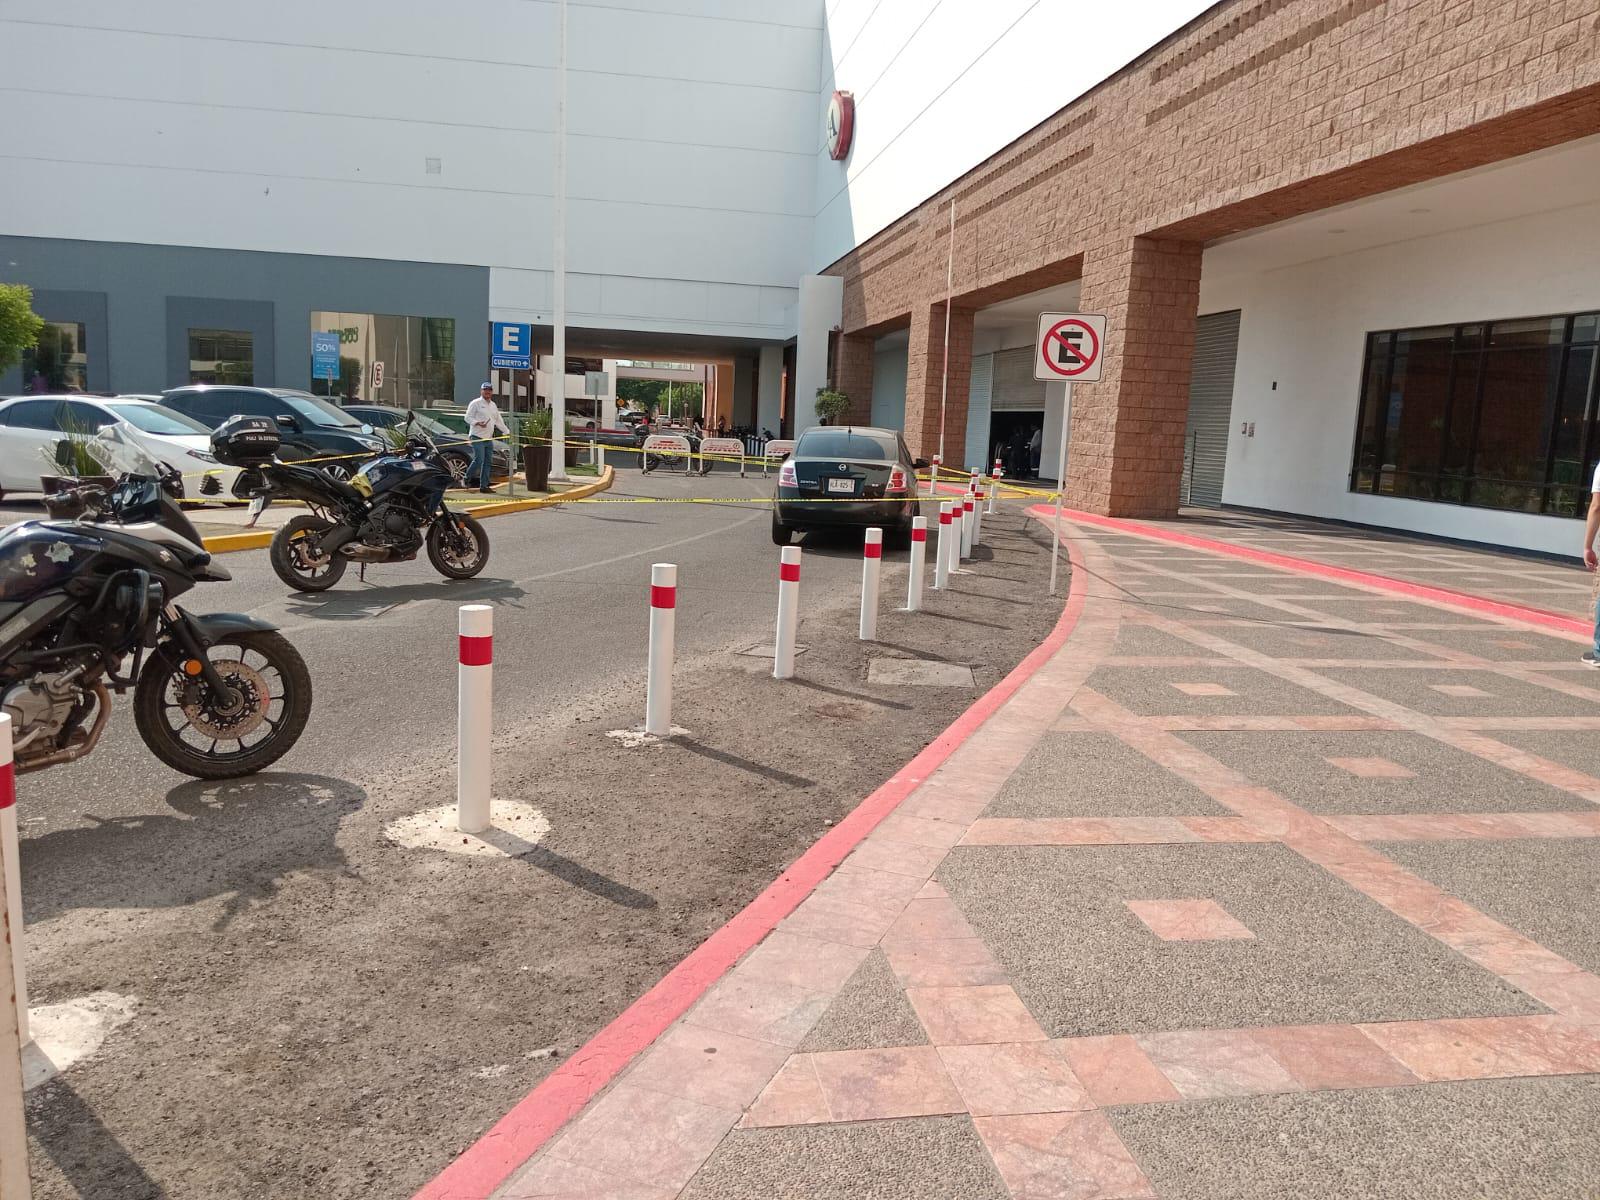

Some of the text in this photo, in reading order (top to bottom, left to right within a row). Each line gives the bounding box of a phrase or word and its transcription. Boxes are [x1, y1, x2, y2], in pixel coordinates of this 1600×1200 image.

[316, 343, 336, 352] 50%
[503, 326, 520, 352] E
[1058, 331, 1083, 363] E
[494, 359, 522, 367] CUBIERTO
